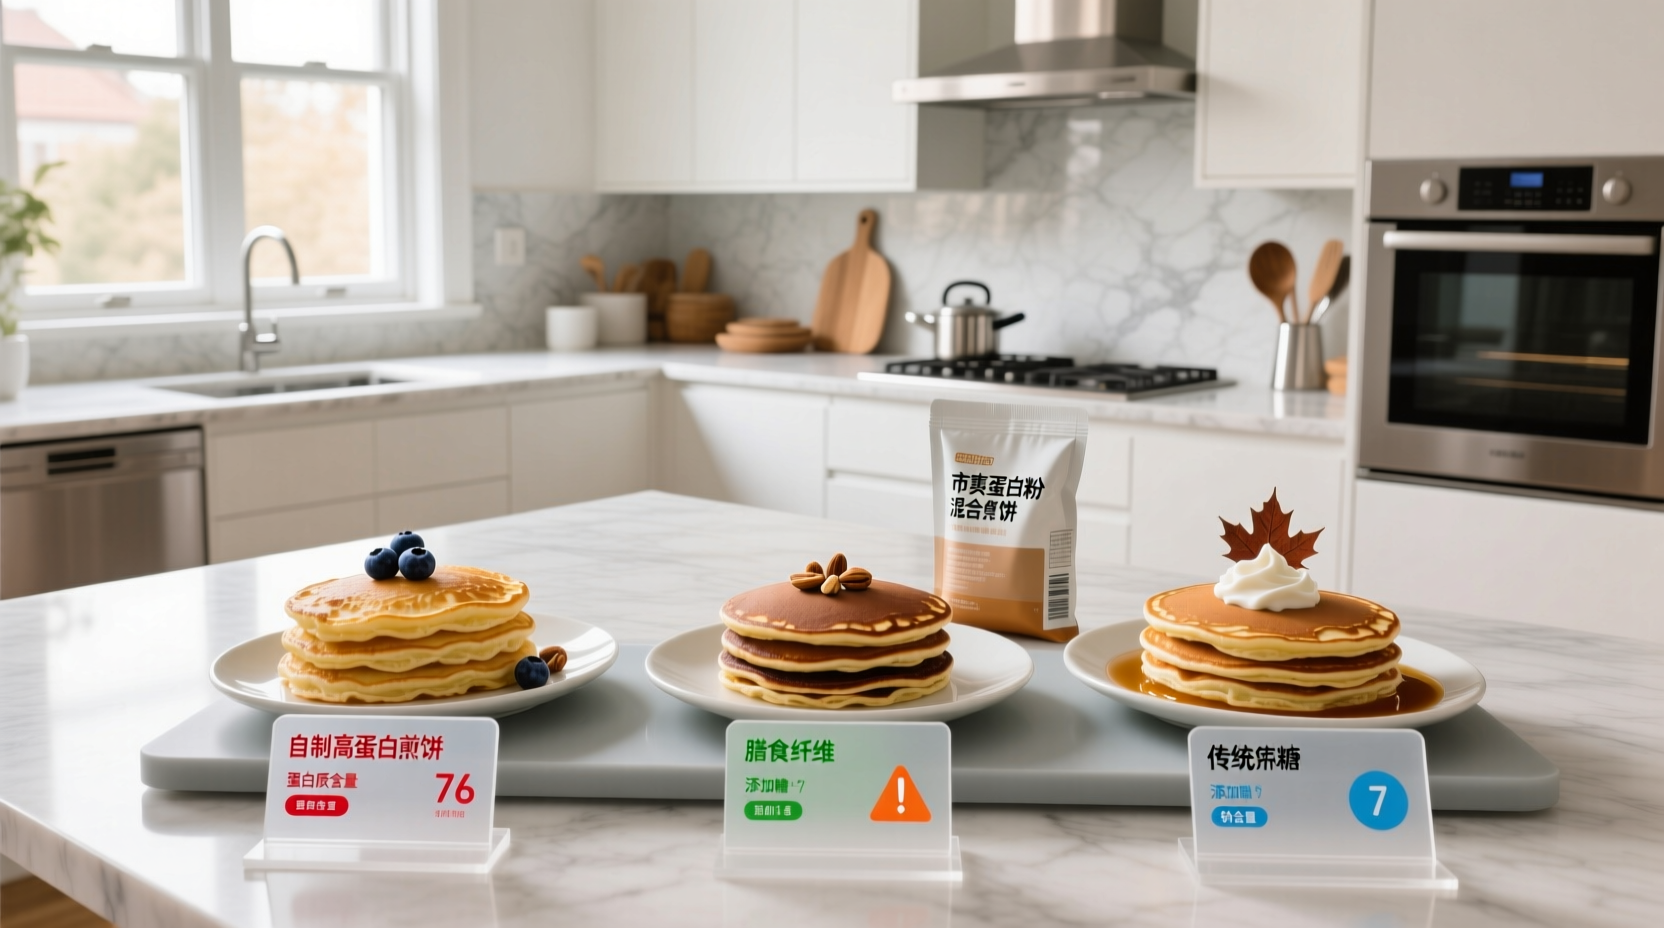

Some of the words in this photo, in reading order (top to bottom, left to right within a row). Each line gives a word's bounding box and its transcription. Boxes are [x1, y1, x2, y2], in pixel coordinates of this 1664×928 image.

[289, 733, 444, 760] 自制高蛋白煎饼
[745, 738, 835, 763] 膳食纤维
[435, 773, 475, 804] 76
[1368, 785, 1388, 817] 7
